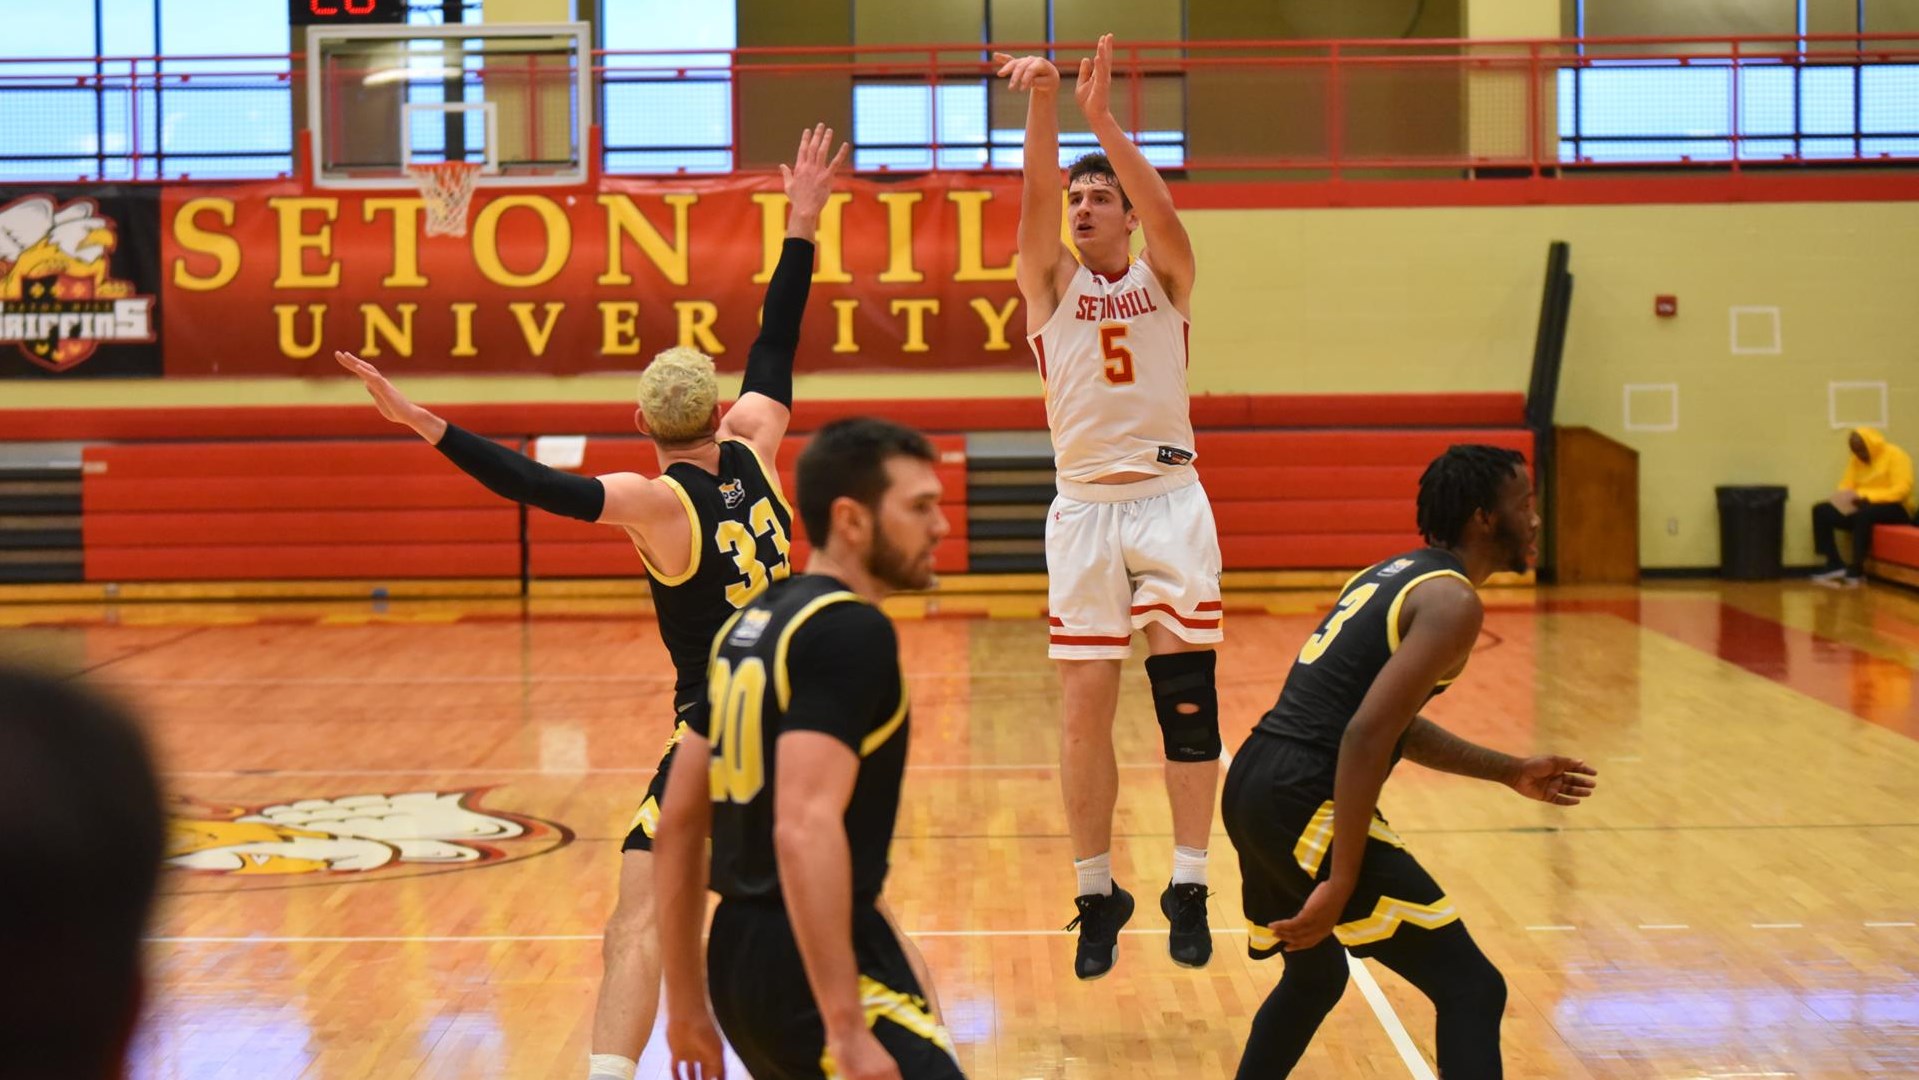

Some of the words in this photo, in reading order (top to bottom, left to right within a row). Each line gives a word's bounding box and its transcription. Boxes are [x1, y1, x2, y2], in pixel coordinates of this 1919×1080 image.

[172, 195, 699, 290] SETON
[0, 299, 150, 340] RIFFINS
[274, 297, 1021, 359] UNIVERITY
[1115, 287, 1157, 320] HILL
[1099, 324, 1135, 386] 5
[714, 496, 791, 609] 33
[1298, 582, 1380, 665] 3
